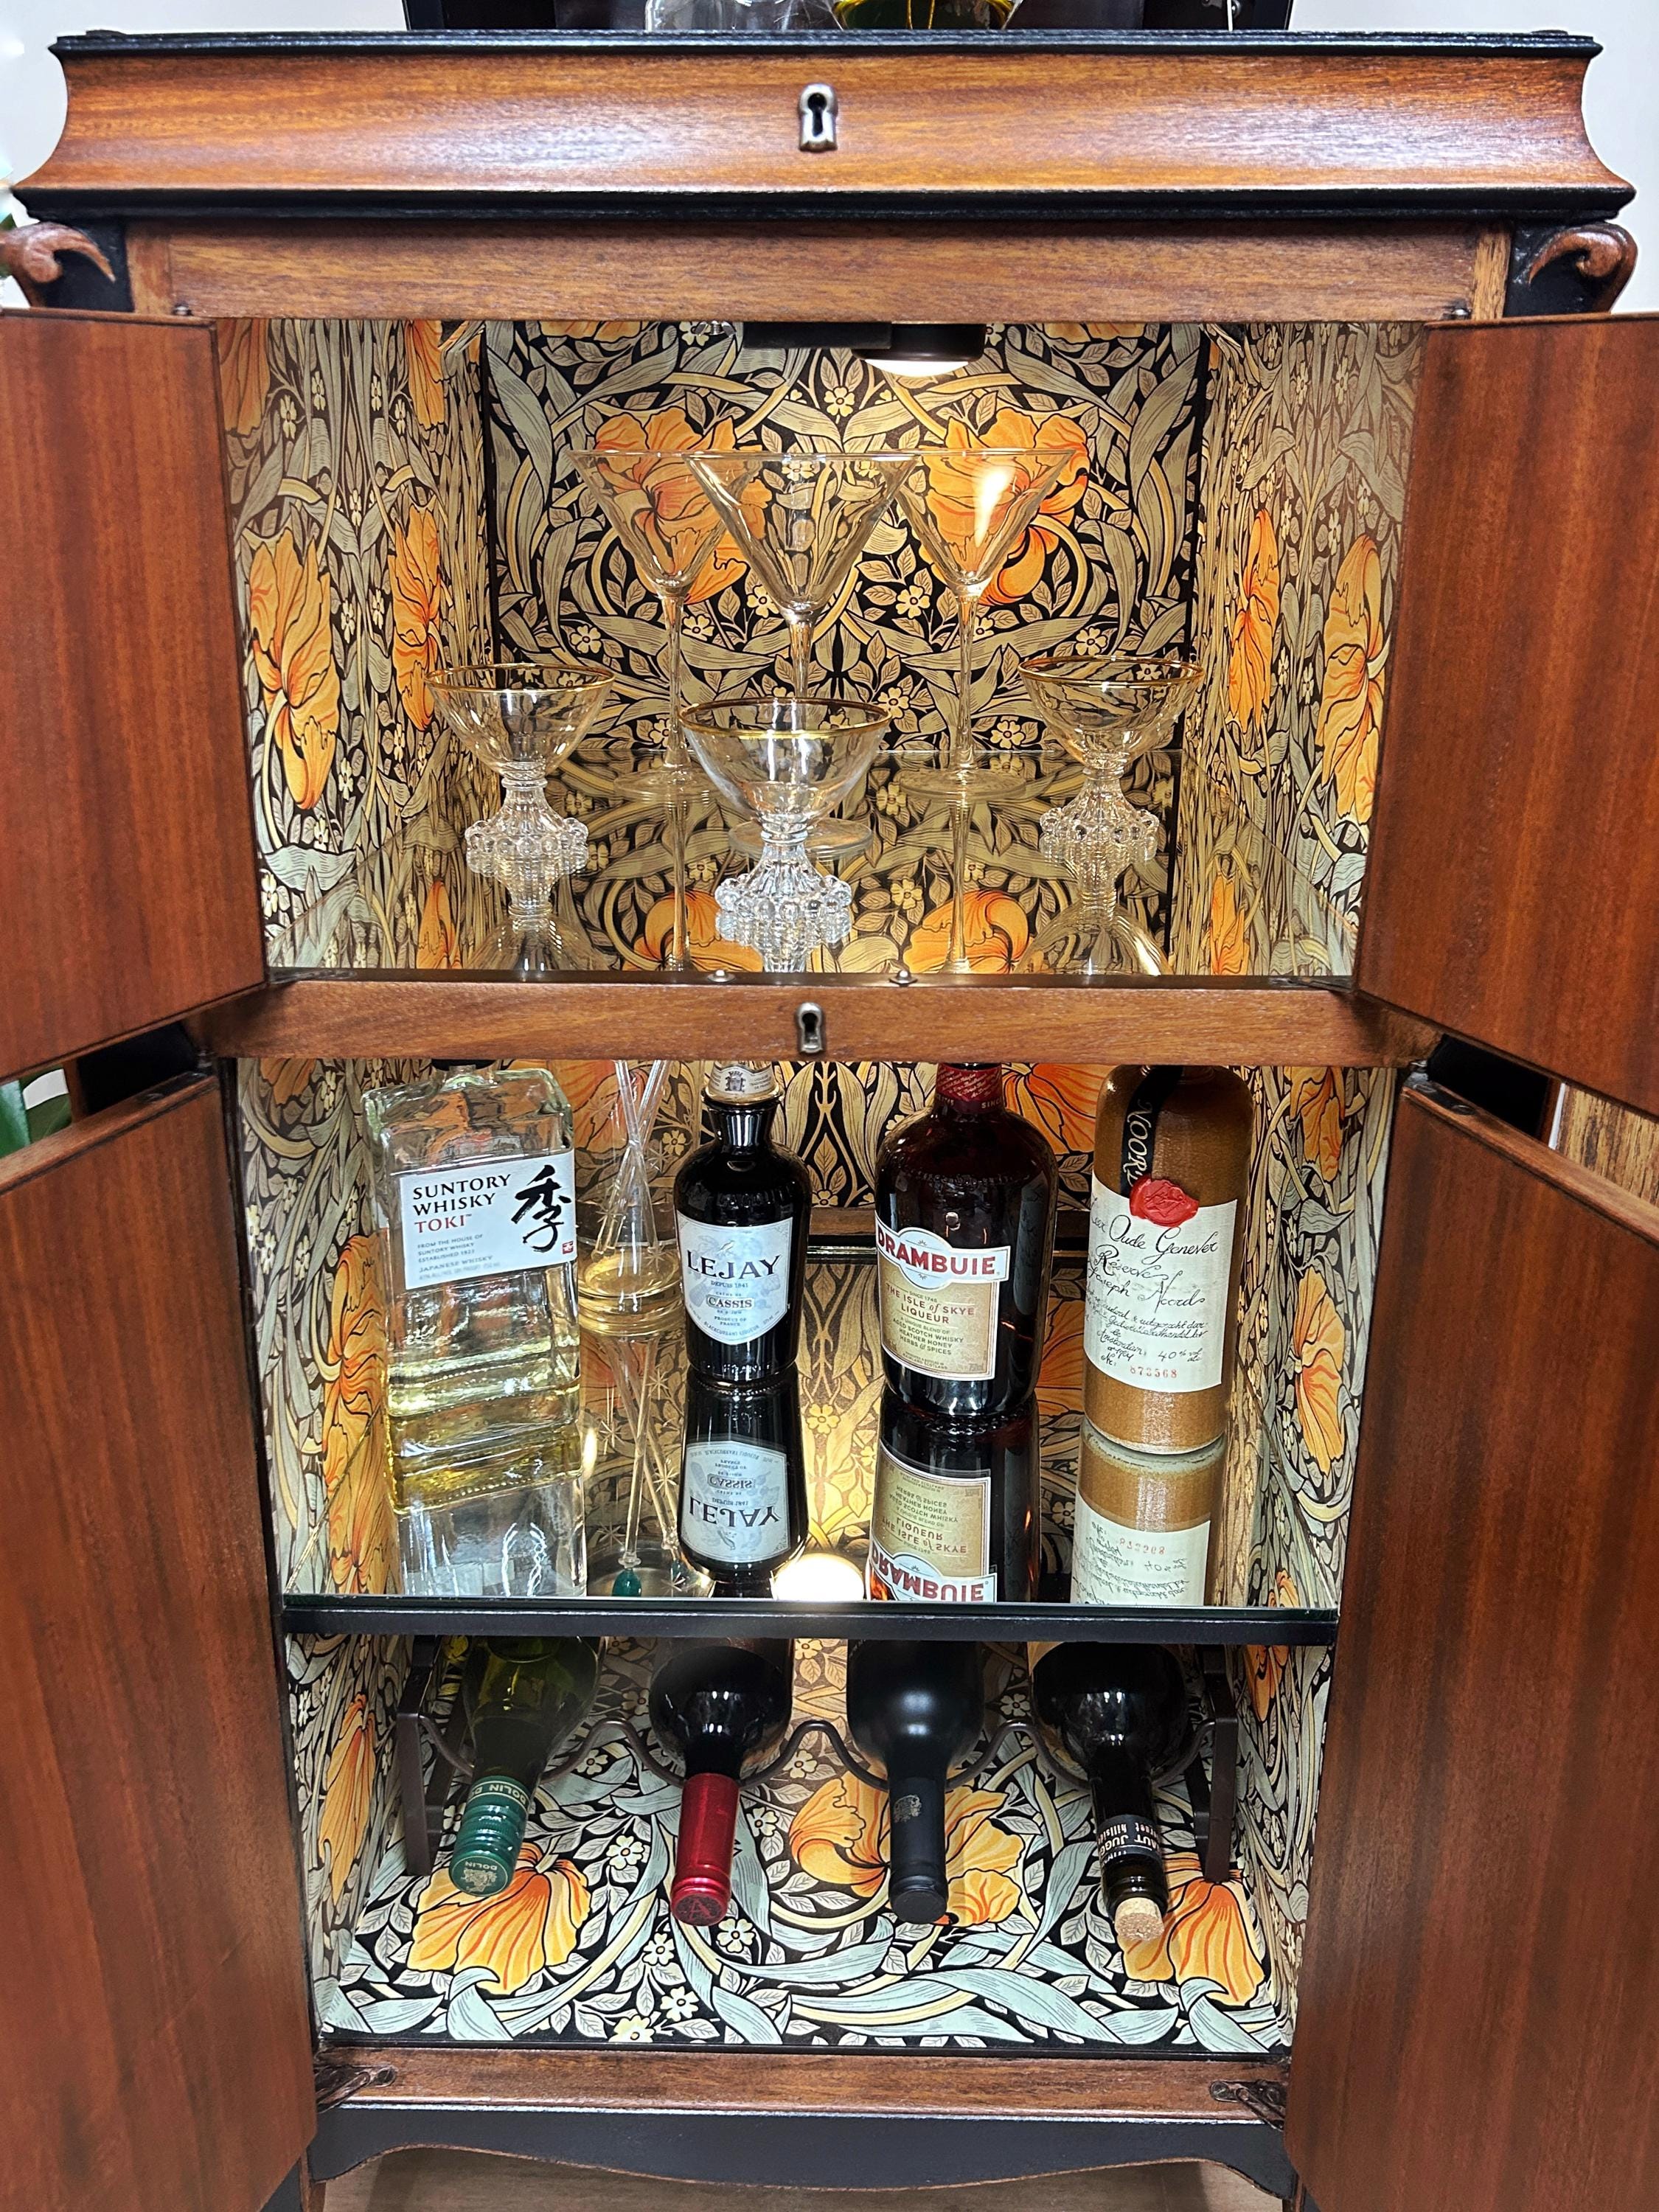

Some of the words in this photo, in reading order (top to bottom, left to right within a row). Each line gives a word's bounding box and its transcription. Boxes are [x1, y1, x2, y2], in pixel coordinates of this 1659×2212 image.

[413, 1174, 511, 1200] SUNTORY
[413, 1192, 495, 1216] WHISKY
[511, 1164, 572, 1253] 季
[418, 1246, 449, 1256] SUNTORY
[450, 1242, 475, 1251] WHISKY
[1109, 1214, 1147, 1250] Oude
[1141, 1226, 1219, 1265] Genever
[418, 1252, 459, 1263] ESTABLISHED
[877, 1226, 996, 1276] DRAMBUIE
[419, 1261, 459, 1273] JAPANESE
[462, 1255, 493, 1265] WHISKY
[686, 1249, 782, 1279] LEJAY
[710, 1280, 733, 1288] DEPUIS
[708, 1296, 752, 1308] CASSIS
[886, 1283, 900, 1298] THE
[903, 1294, 925, 1309] ISLE
[929, 1303, 941, 1314] of
[942, 1306, 975, 1315] SKYE
[909, 1290, 923, 1300] SINCE
[901, 1303, 950, 1324] LIQUEUR
[703, 1321, 738, 1336] BLACKCURRANT
[893, 1318, 907, 1329] AGED
[908, 1325, 933, 1338] SCOTCH
[935, 1334, 964, 1343] WHISKY
[923, 1325, 941, 1333] BLEND
[900, 1329, 926, 1343] HEATHER
[928, 1339, 953, 1349] HONEY
[900, 1335, 919, 1347] HERBS
[927, 1346, 952, 1355] SPICES
[1158, 1351, 1177, 1362] 40
[489, 1784, 526, 1805] DOLIN
[465, 1861, 498, 1871] DOLIN
